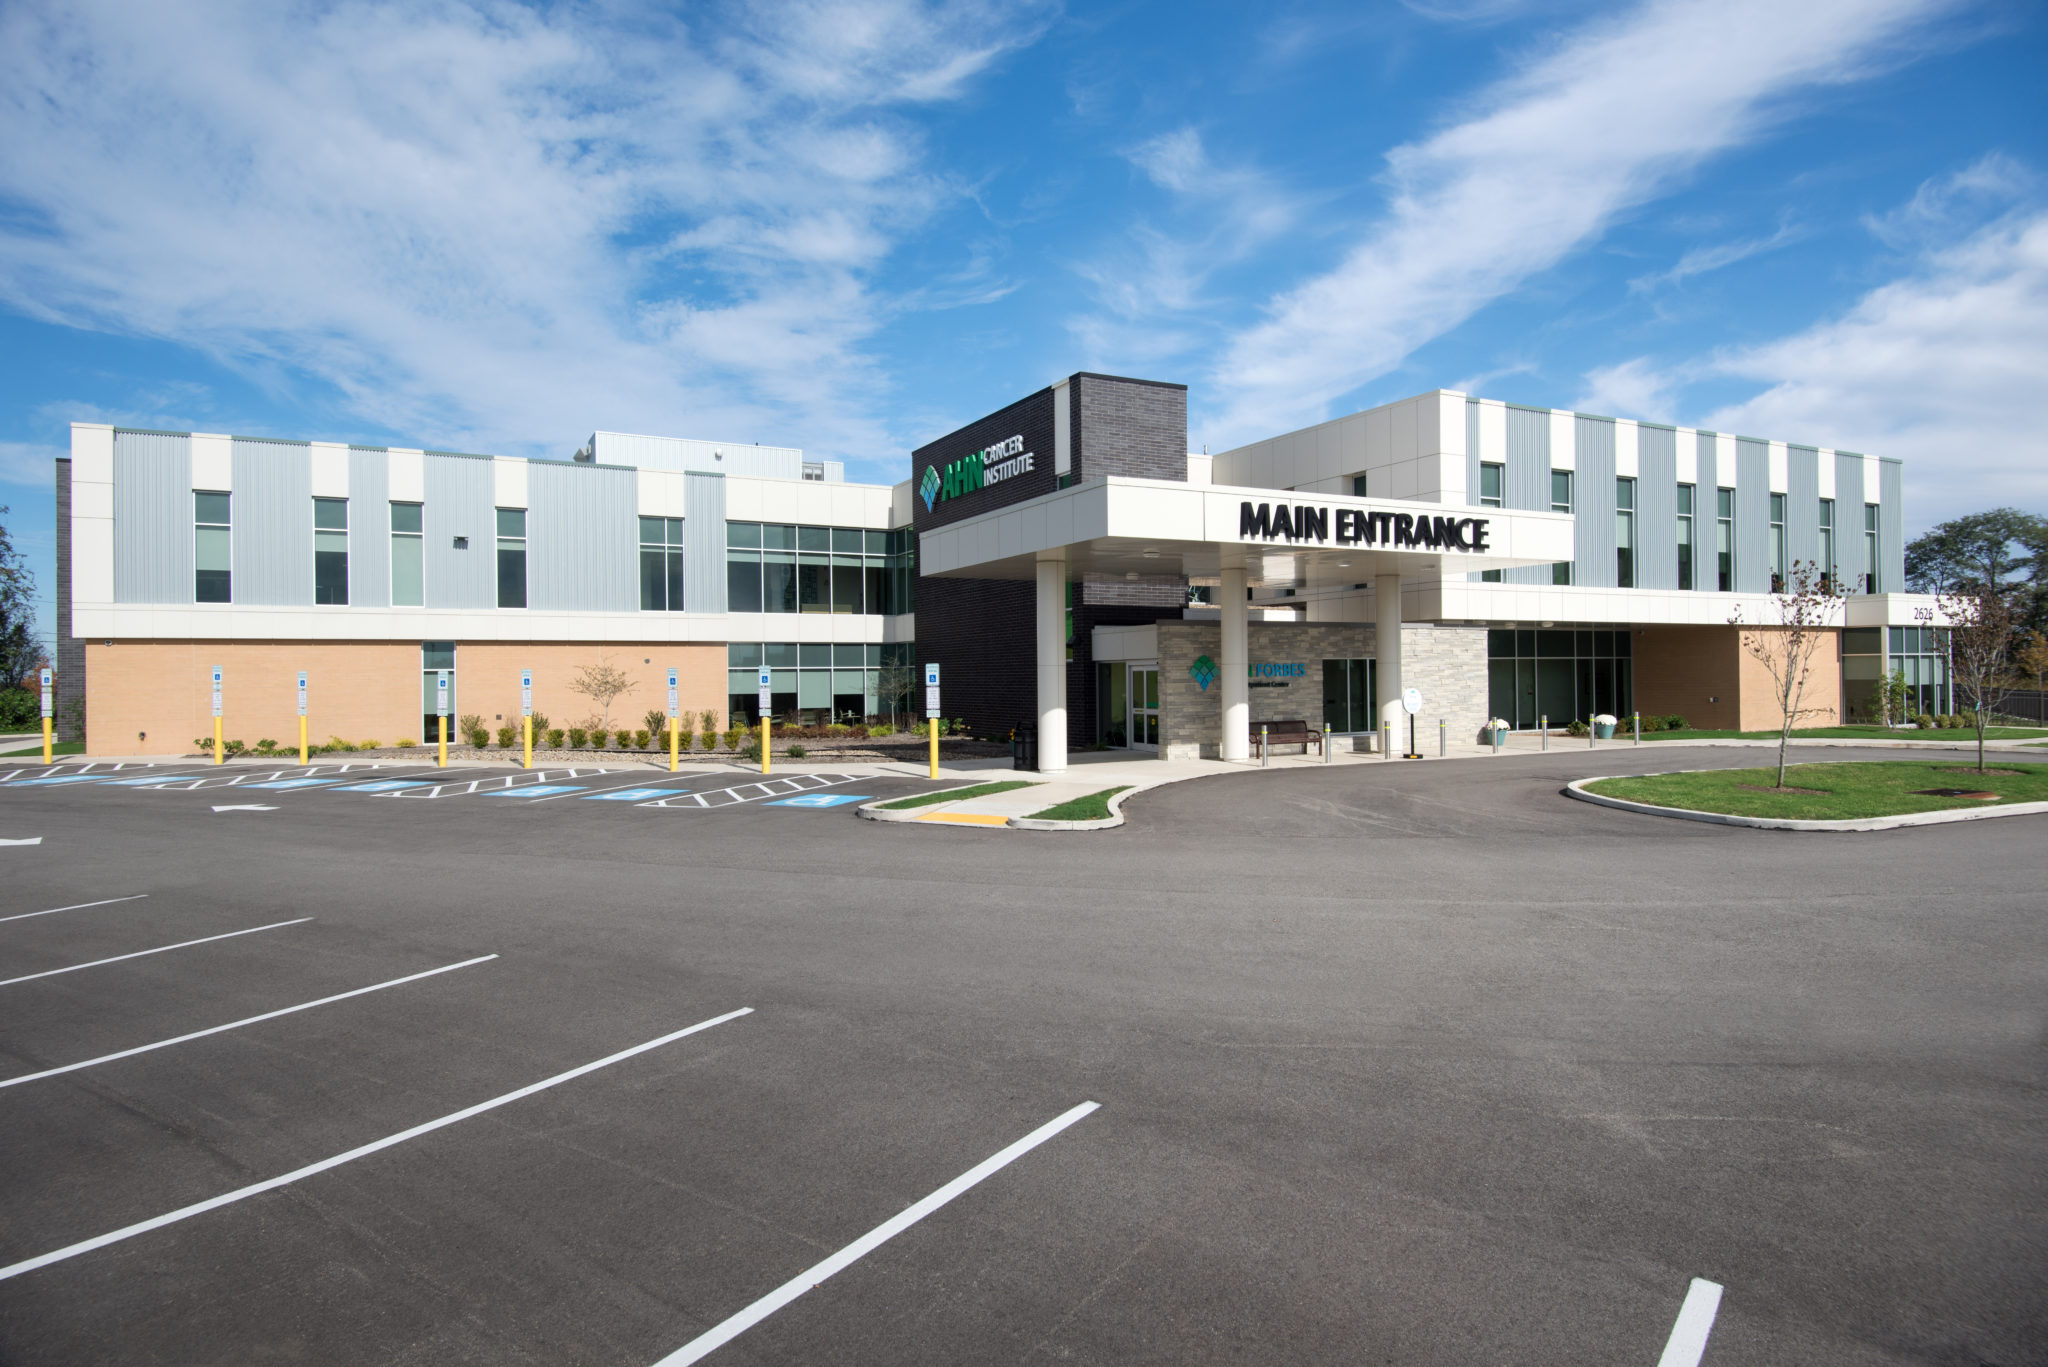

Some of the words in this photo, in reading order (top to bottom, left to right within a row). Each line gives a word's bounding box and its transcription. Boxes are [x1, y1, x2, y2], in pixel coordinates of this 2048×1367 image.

[983, 435, 1024, 464] CANCER
[942, 451, 984, 501] AHN
[983, 452, 1035, 487] INSTITUTE
[1240, 502, 1328, 541] MAIN
[1336, 509, 1489, 549] ENTRANCE
[1914, 607, 1933, 620] 2626
[1256, 663, 1306, 677] FORBES
